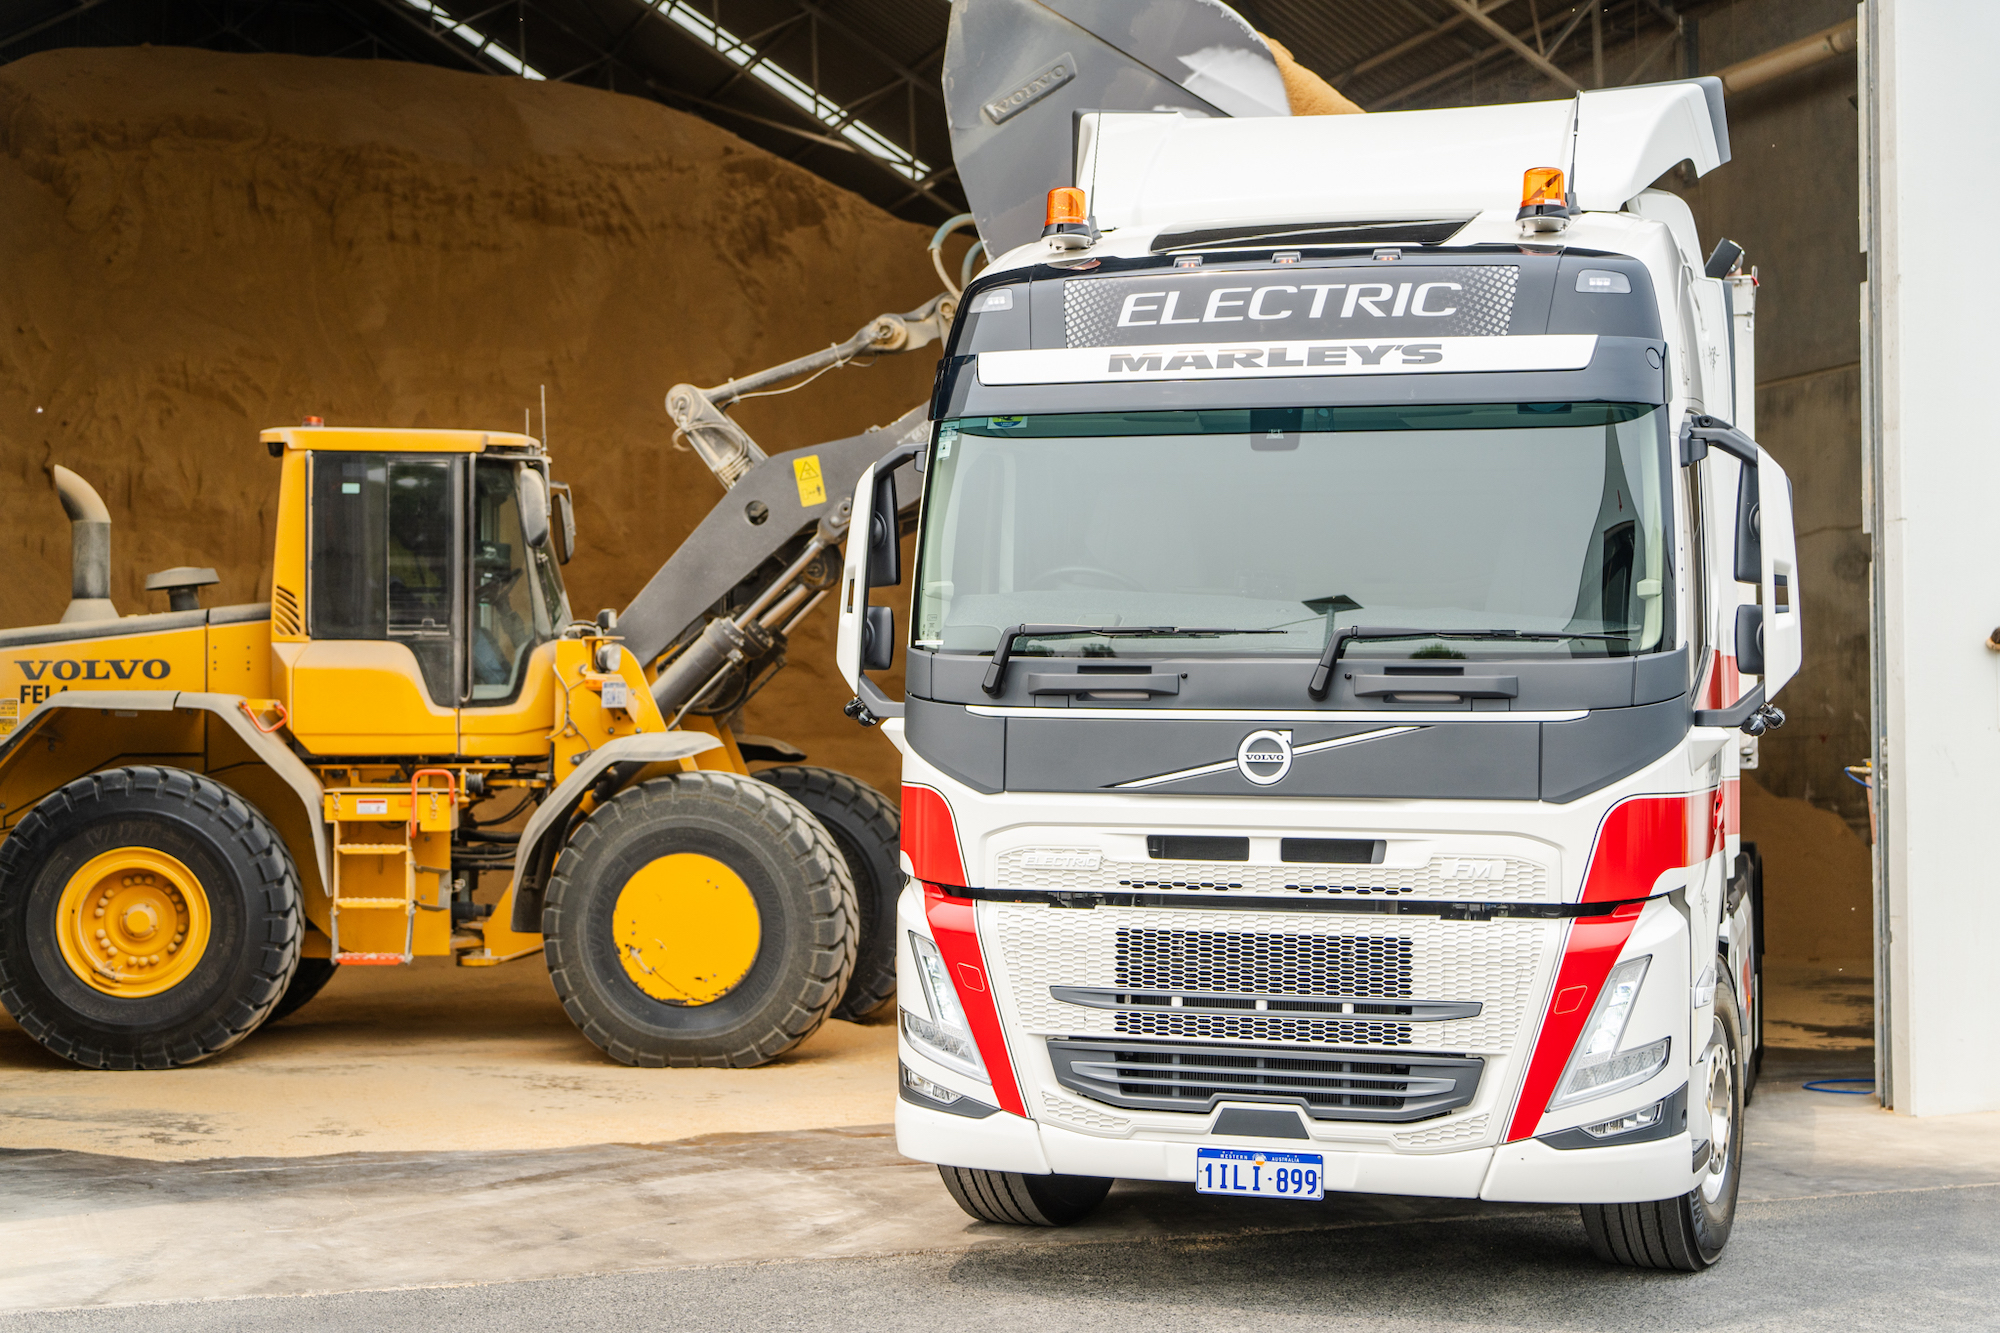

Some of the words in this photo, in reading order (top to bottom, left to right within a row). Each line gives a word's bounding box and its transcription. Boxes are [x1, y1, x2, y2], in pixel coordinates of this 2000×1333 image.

[993, 64, 1067, 113] VOLVO
[1117, 282, 1462, 327] ELECTRIC
[1108, 344, 1443, 373] MARLEY'S
[14, 659, 171, 680] VOLVO
[1025, 856, 1098, 867] ELECTRIC
[1452, 863, 1492, 878] FM
